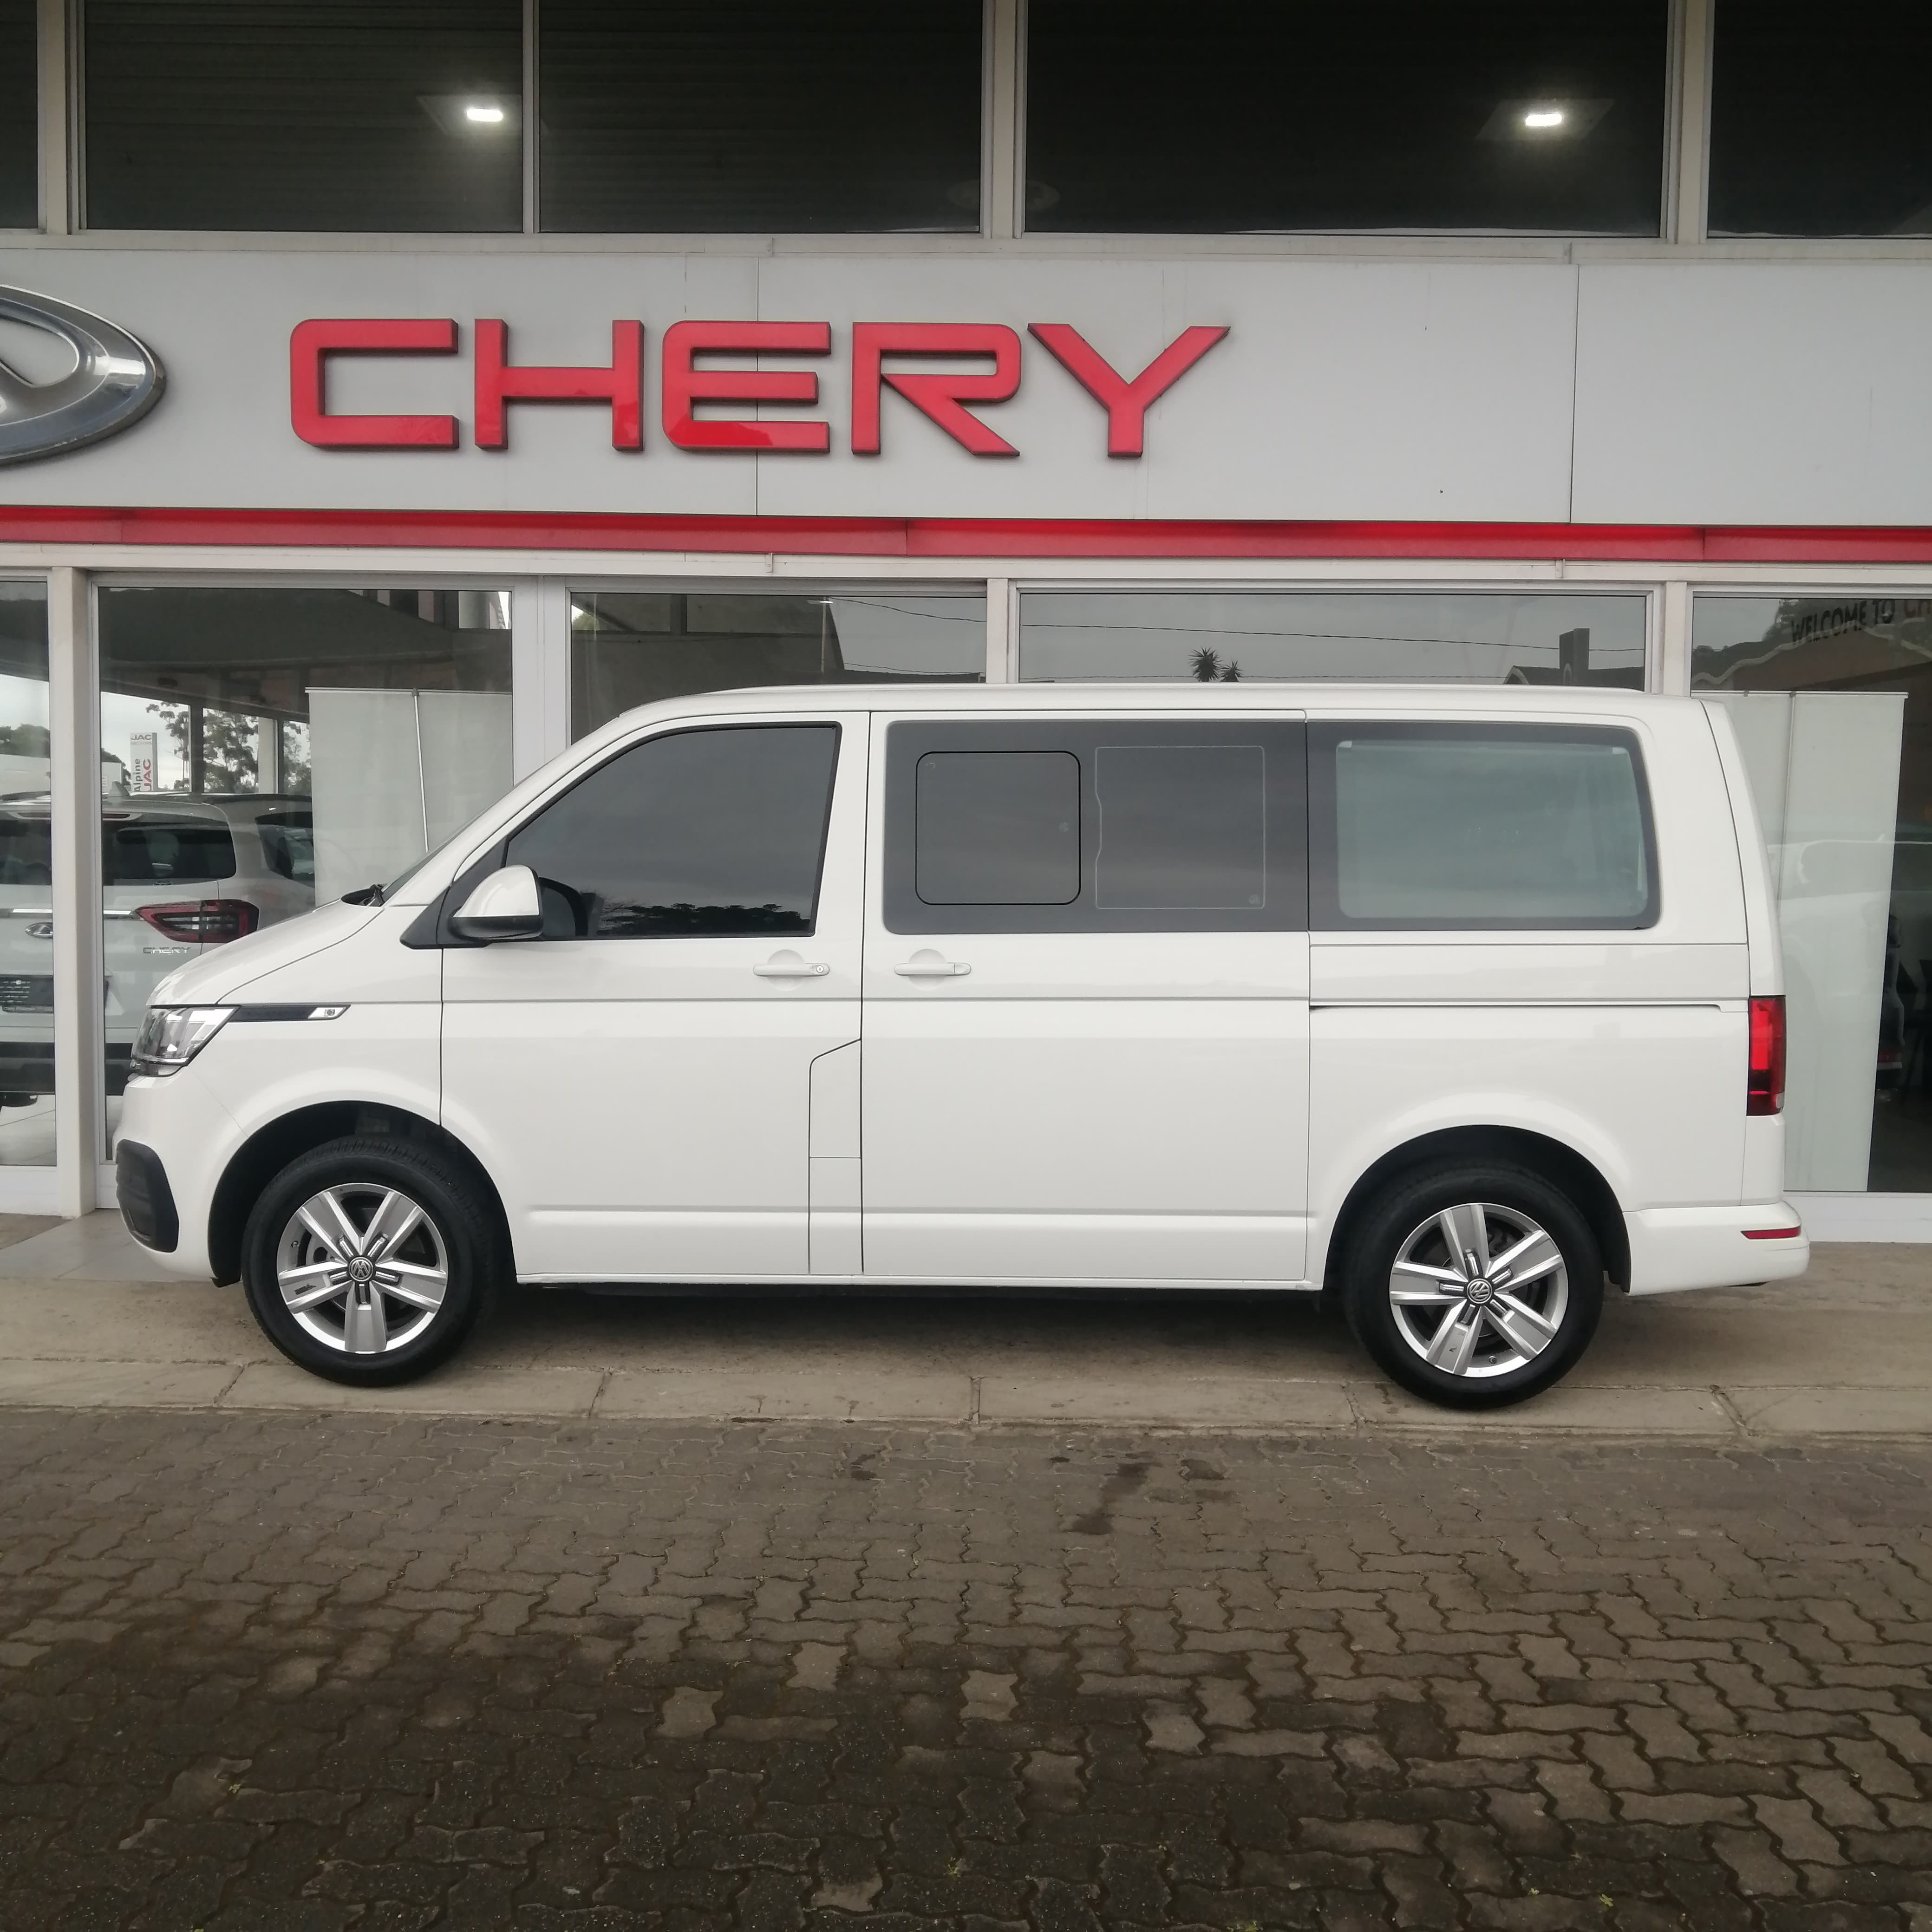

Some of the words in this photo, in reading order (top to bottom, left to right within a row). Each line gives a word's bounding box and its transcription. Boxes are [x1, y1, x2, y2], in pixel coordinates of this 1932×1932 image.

[290, 318, 1231, 458] CHERY
[1791, 600, 1867, 642] WELCOME
[1872, 600, 1895, 625] TO
[133, 758, 143, 791] Alpine
[143, 758, 152, 791] JAC
